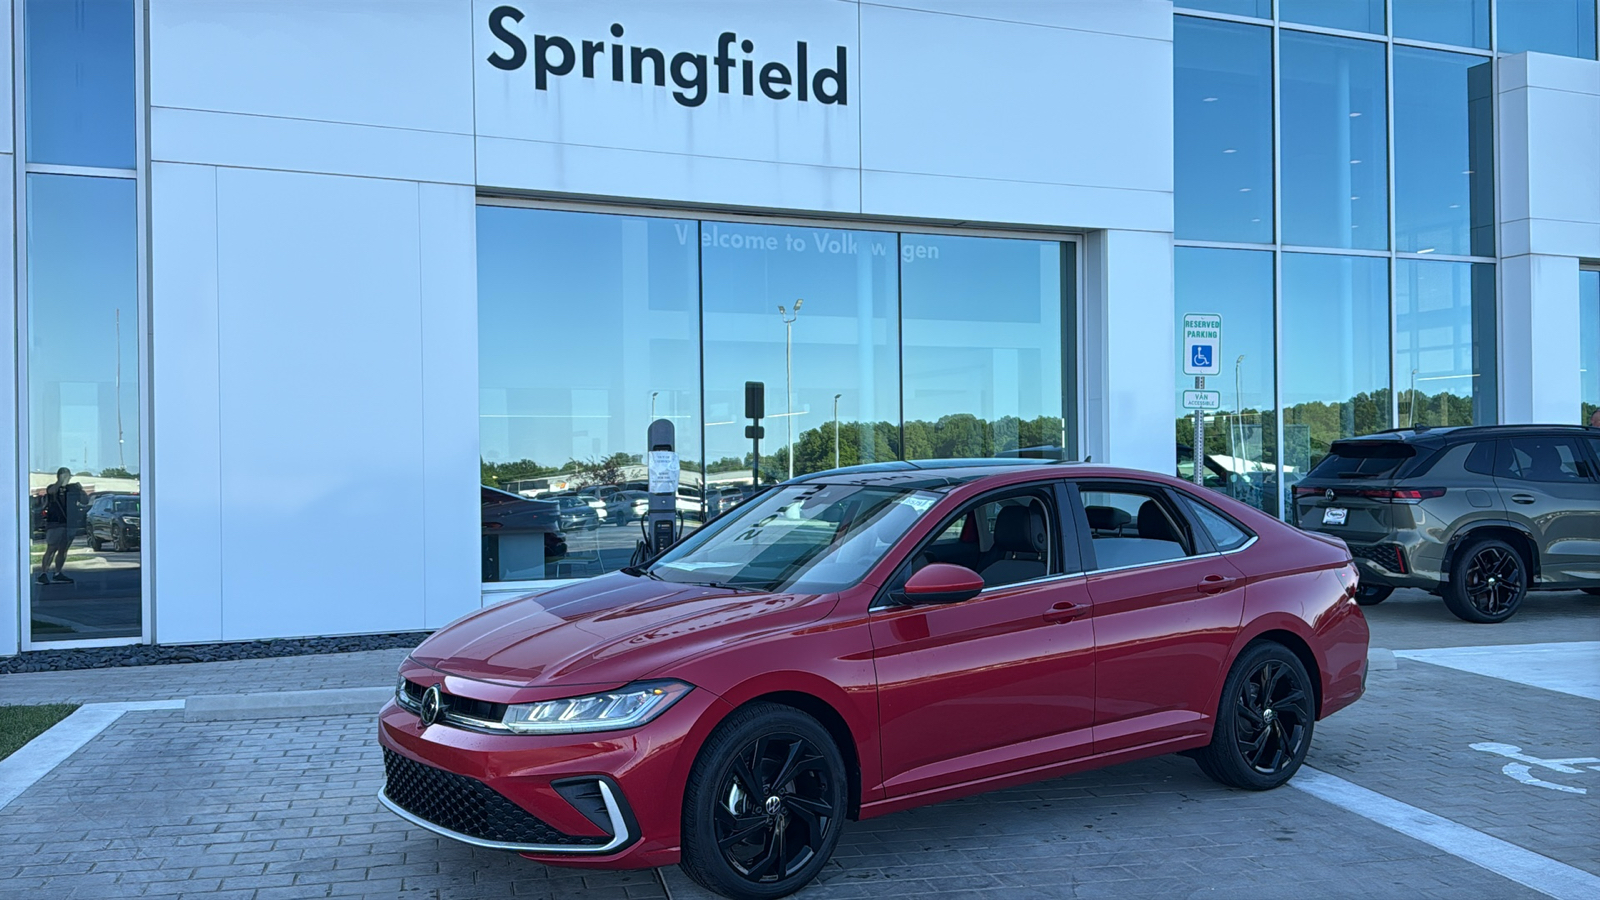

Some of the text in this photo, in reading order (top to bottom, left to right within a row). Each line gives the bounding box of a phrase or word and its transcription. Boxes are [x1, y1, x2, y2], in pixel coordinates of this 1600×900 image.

[486, 5, 848, 107] Springfield
[785, 233, 806, 252] to
[813, 232, 939, 263] Volkwgen
[1185, 320, 1220, 328] RESERVED
[1187, 330, 1217, 338] PARKING
